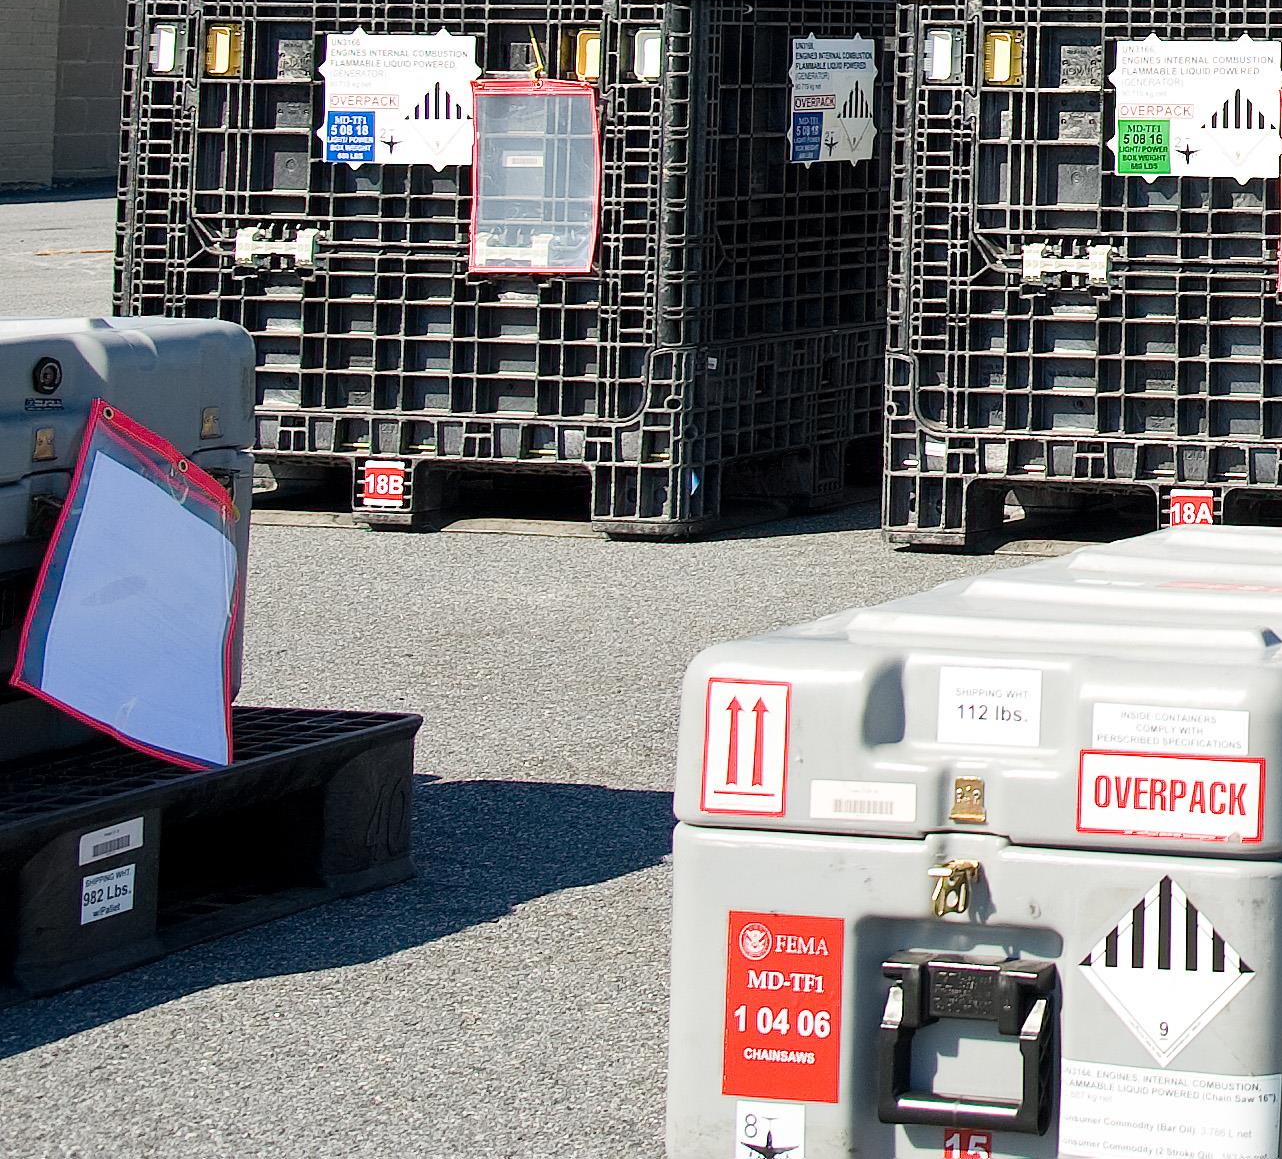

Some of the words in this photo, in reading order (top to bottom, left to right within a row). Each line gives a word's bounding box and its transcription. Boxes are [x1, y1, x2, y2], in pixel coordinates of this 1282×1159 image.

[330, 49, 367, 57] ENGINES
[369, 49, 409, 57] INTERNAL
[1121, 56, 1161, 64] ENGINES
[1163, 56, 1209, 64] INTERNAL
[330, 60, 381, 68] FLAMMABLE
[383, 60, 411, 68] LIQUID
[1120, 67, 1177, 76] FLAMMABLE
[1179, 67, 1211, 75] LIQUID
[1212, 67, 1260, 75] POWERED
[330, 95, 397, 107] OVERPACK
[794, 97, 835, 108] OVERPACK
[1119, 105, 1192, 116] OVERPACK
[333, 115, 367, 125] MD-TF1
[330, 125, 338, 136] 5
[338, 125, 353, 136] 08
[355, 125, 369, 136] 18
[796, 126, 801, 136] 5
[1126, 124, 1162, 133] MD-TF1
[1123, 134, 1130, 145] 5
[1132, 134, 1146, 145] 08
[1148, 134, 1163, 144] 16
[365, 474, 405, 495] 18B
[1170, 502, 1214, 524] 18A
[955, 687, 1003, 699] SHIPPING
[957, 704, 988, 721] 112
[995, 705, 1028, 723] lbs.
[1120, 711, 1151, 721] INSIDE
[1154, 712, 1217, 724] CONTAINERS
[1135, 723, 1177, 733] COMPLY
[1179, 725, 1204, 735] WITH
[1096, 733, 1160, 745] PERSCRIBED
[1162, 736, 1243, 749] SPECIFICATIONS
[1093, 774, 1247, 817] OVERPACK
[83, 888, 104, 907] 982
[107, 884, 132, 900] Lbs.
[775, 934, 829, 956] FEMA
[747, 969, 825, 994] MD-TF1
[734, 1004, 748, 1032] 1
[756, 1006, 790, 1035] 04
[797, 1009, 831, 1038] 06
[1158, 1022, 1169, 1038] 9
[743, 1047, 816, 1065] CHAINSAWS
[1142, 1075, 1190, 1087] INTERNAL
[1192, 1079, 1263, 1092] COMBUSTION,
[1117, 1083, 1150, 1095] LIQUID
[1151, 1086, 1200, 1100] POWERED
[1202, 1091, 1232, 1103] (Chain
[1234, 1092, 1255, 1103] Saw
[744, 1113, 758, 1138] 8
[1103, 1117, 1153, 1132] Commodity
[1156, 1123, 1176, 1133] (Bar
[1237, 1130, 1252, 1139] net
[945, 1134, 990, 1159] 15
[1103, 1141, 1153, 1155] Commodity
